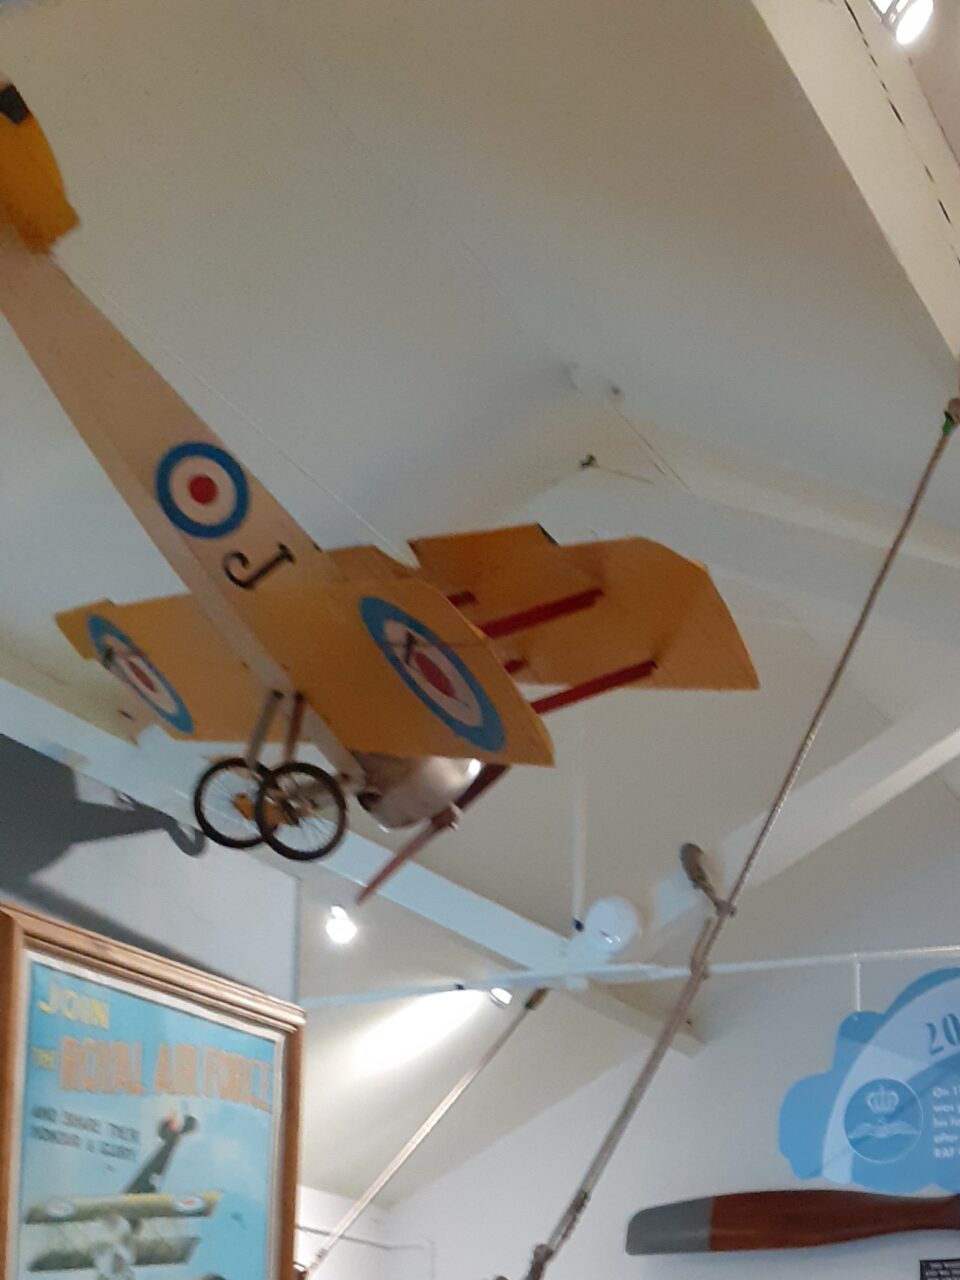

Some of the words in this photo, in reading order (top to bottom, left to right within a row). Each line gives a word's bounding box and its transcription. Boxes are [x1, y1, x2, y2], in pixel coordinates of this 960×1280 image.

[222, 541, 296, 589] J
[38, 979, 110, 1031] JOIN
[61, 1034, 146, 1096] ROYAL
[154, 1042, 198, 1096] AIR
[202, 1046, 273, 1114] FORCE
[933, 1088, 948, 1097] On
[933, 1118, 947, 1127] his
[934, 1134, 958, 1143] after
[934, 1148, 954, 1158] RAF
